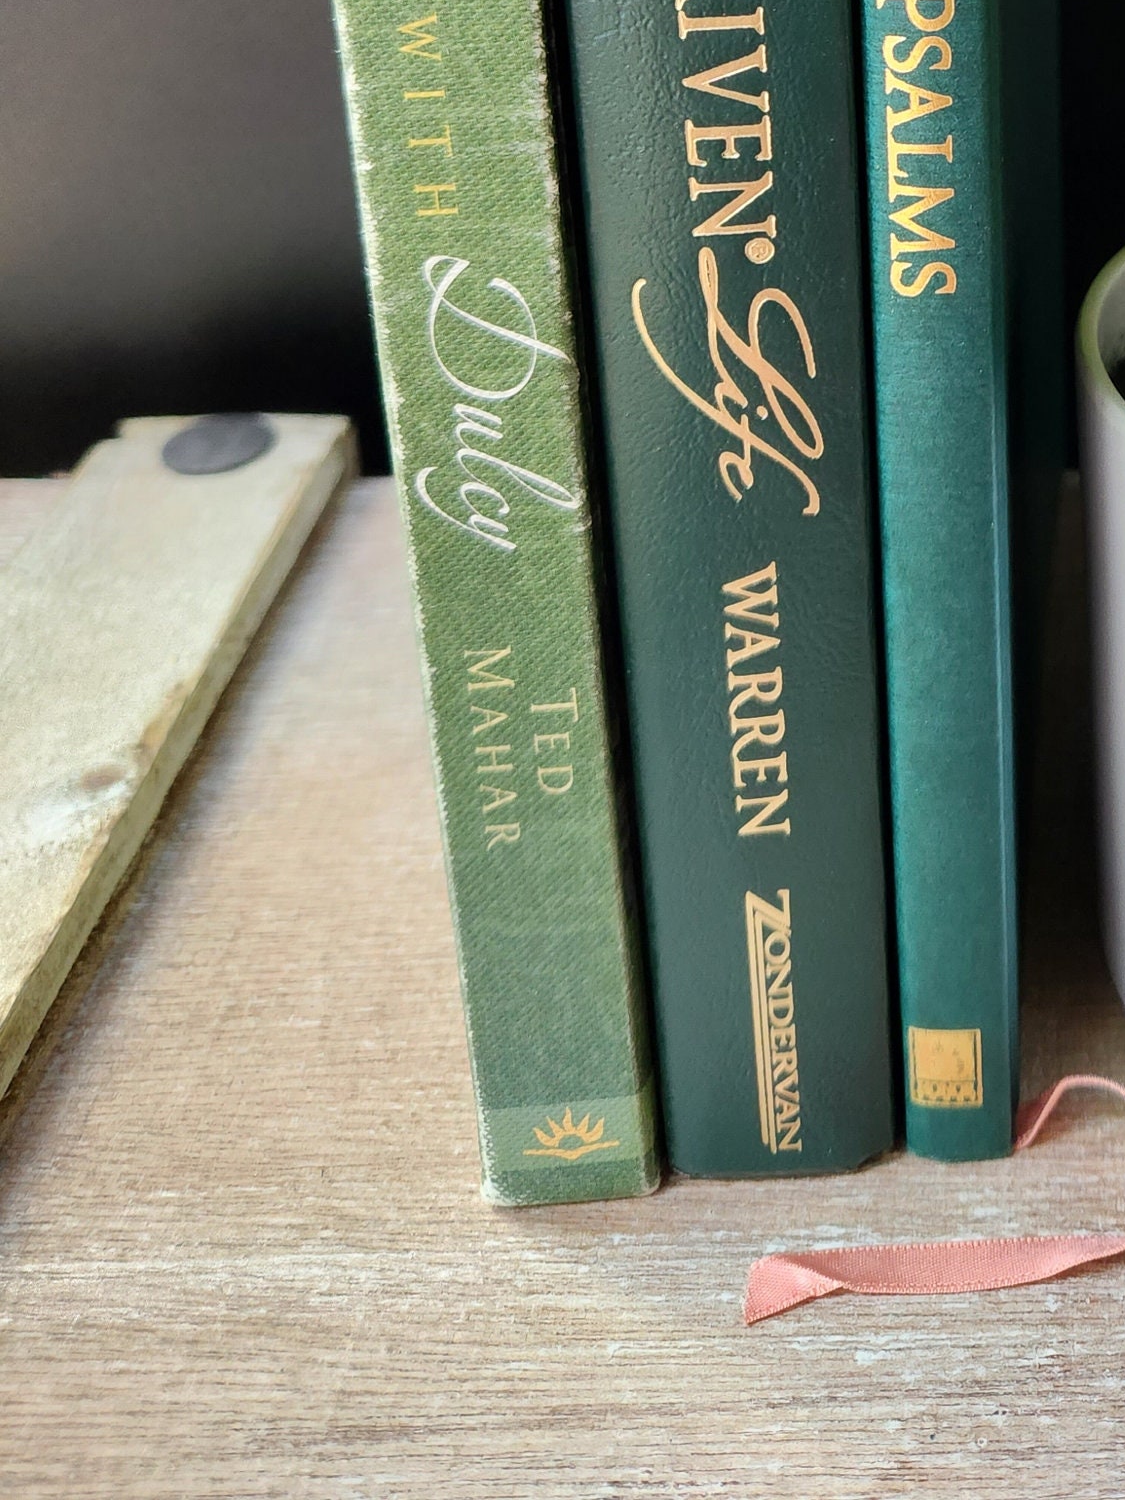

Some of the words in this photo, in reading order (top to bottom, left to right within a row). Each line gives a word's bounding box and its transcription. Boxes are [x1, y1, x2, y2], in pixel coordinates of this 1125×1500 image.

[398, 13, 460, 219] WITH
[415, 255, 581, 551] Dulcy
[632, 246, 825, 517] Life
[463, 645, 523, 852] MAHAR
[529, 686, 580, 795] TED
[721, 559, 792, 838] WARREN
[743, 887, 803, 1153] ZONDERVAN
